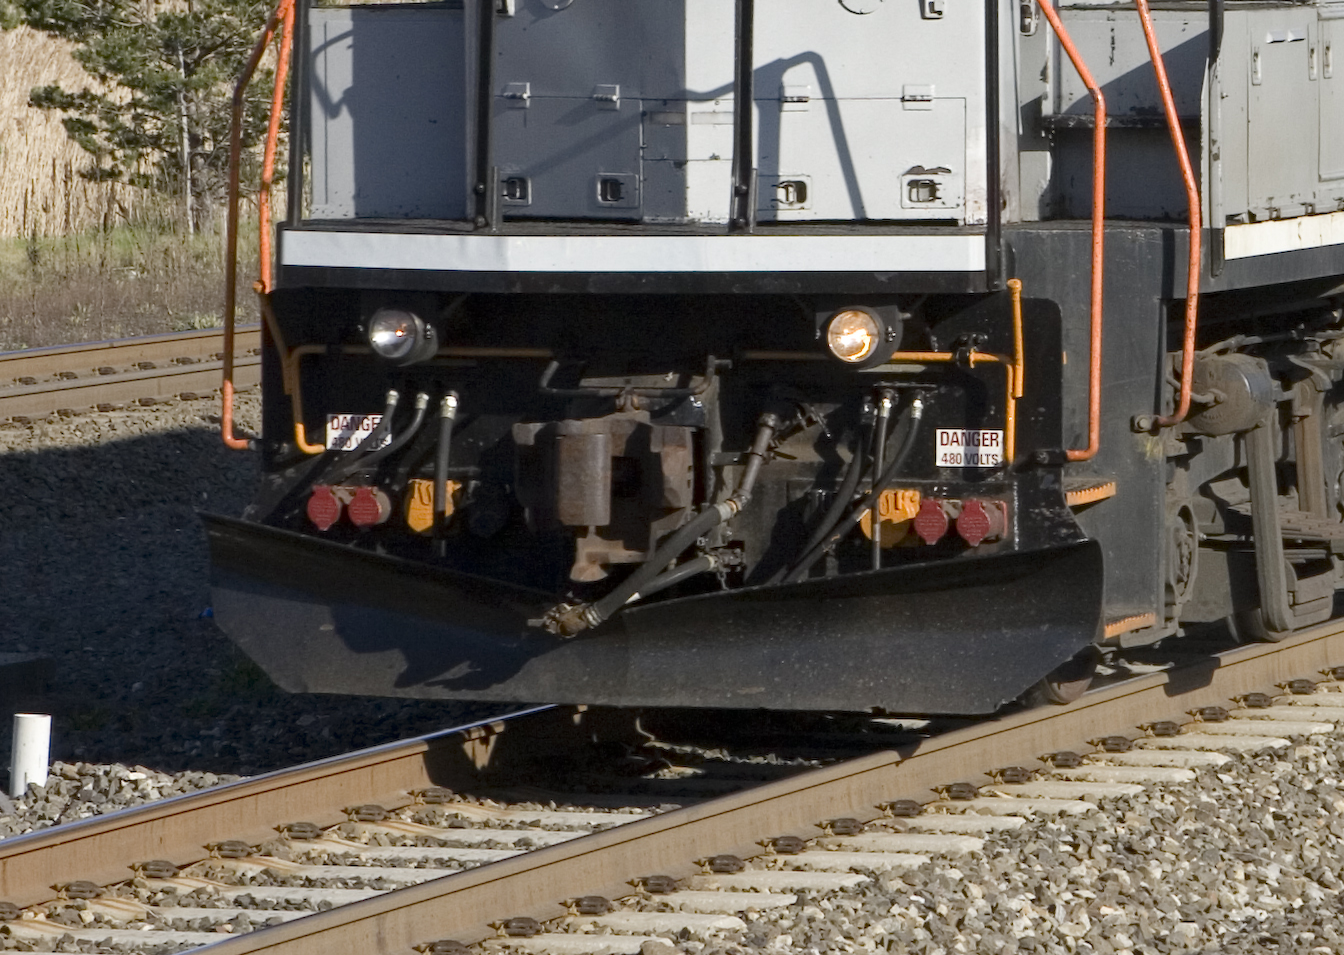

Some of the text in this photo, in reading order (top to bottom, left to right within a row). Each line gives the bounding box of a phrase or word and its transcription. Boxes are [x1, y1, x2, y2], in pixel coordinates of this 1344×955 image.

[331, 416, 381, 432] DANGE
[940, 431, 999, 447] DANGER
[941, 452, 999, 465] 480 VOLTS
